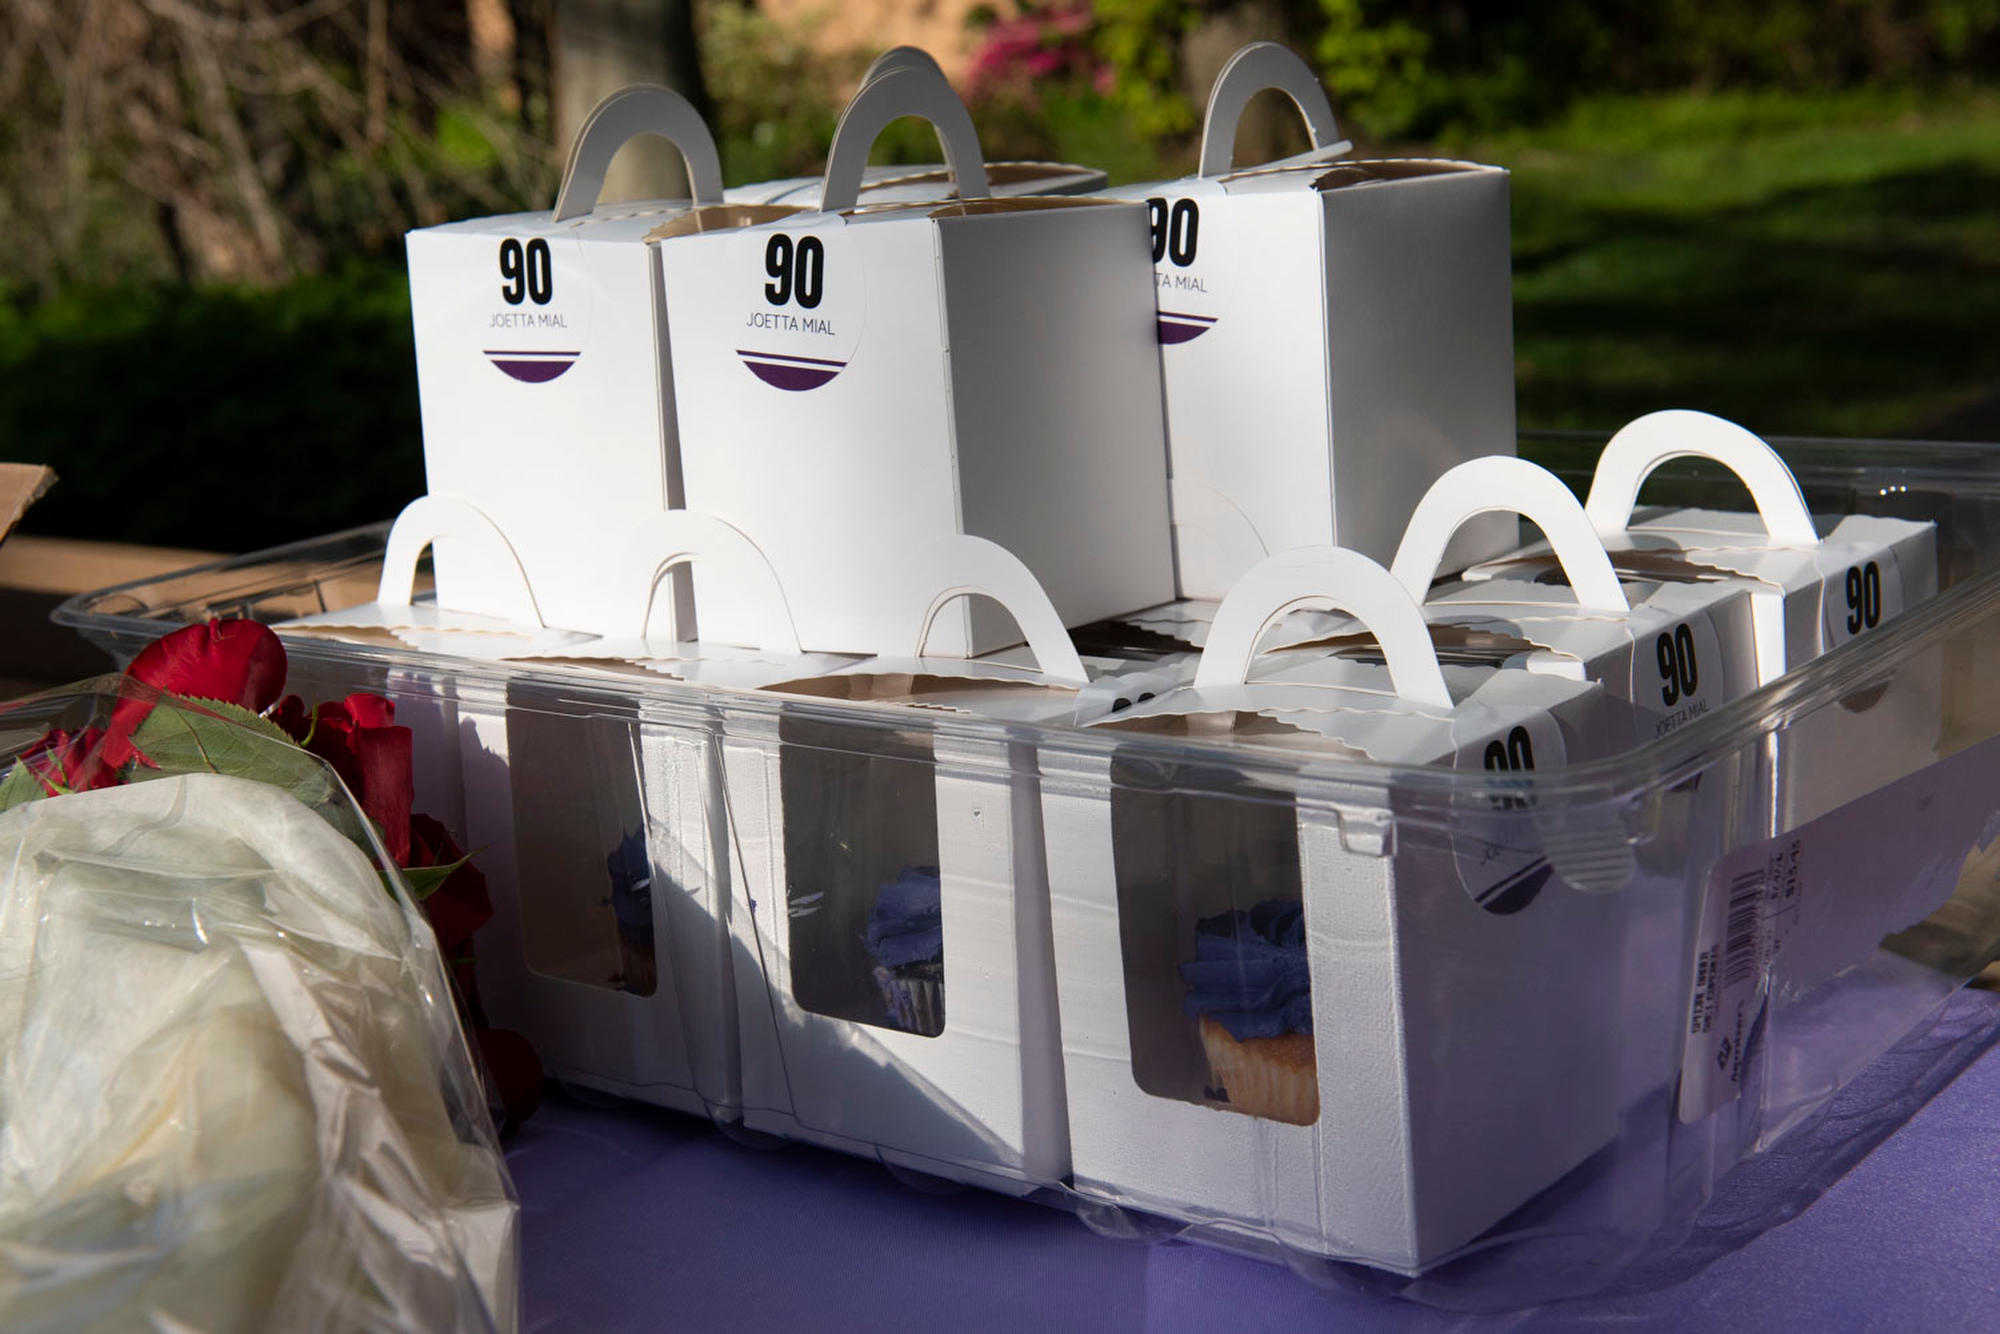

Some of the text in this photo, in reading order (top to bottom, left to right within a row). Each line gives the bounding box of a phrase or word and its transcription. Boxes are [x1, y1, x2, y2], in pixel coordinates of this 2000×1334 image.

[1147, 197, 1200, 267] 90
[499, 238, 553, 305] 90
[765, 233, 825, 309] 90
[1175, 275, 1208, 293] MIAL
[489, 313, 568, 329] JOETTA MIAL
[746, 312, 836, 336] JOETTA MIAL
[1845, 561, 1881, 635] 90
[1656, 623, 1698, 707] 90
[1654, 700, 1710, 739] JOETTA MIAL
